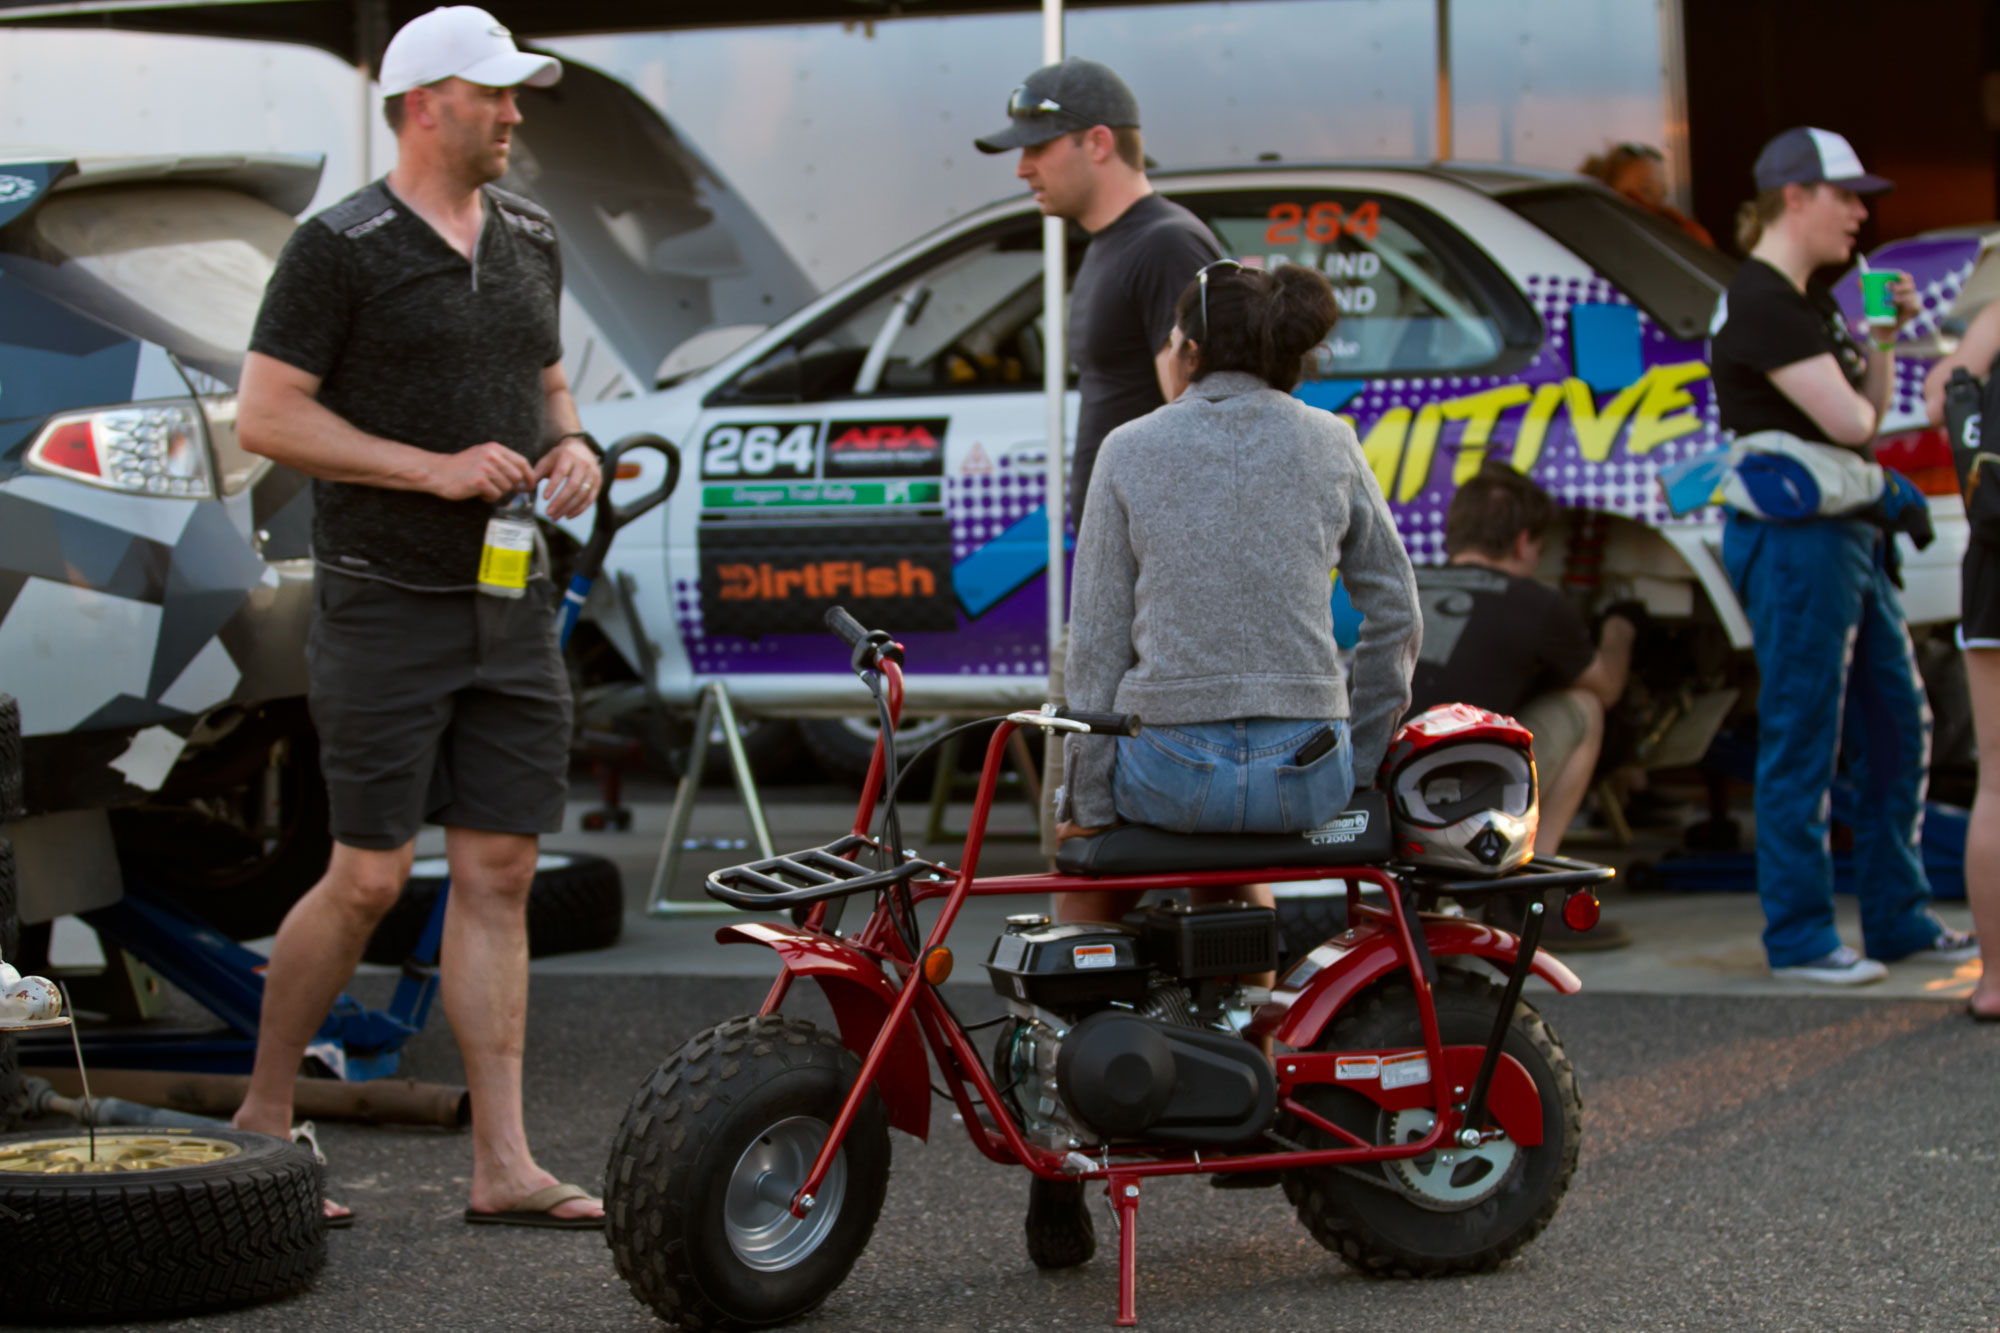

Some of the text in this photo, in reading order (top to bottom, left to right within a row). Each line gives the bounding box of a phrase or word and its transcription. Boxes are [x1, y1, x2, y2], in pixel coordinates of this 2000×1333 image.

[1265, 202, 1381, 243] 264
[703, 425, 814, 474] 264
[830, 425, 938, 451] ARA
[716, 559, 936, 600] DirtFish
